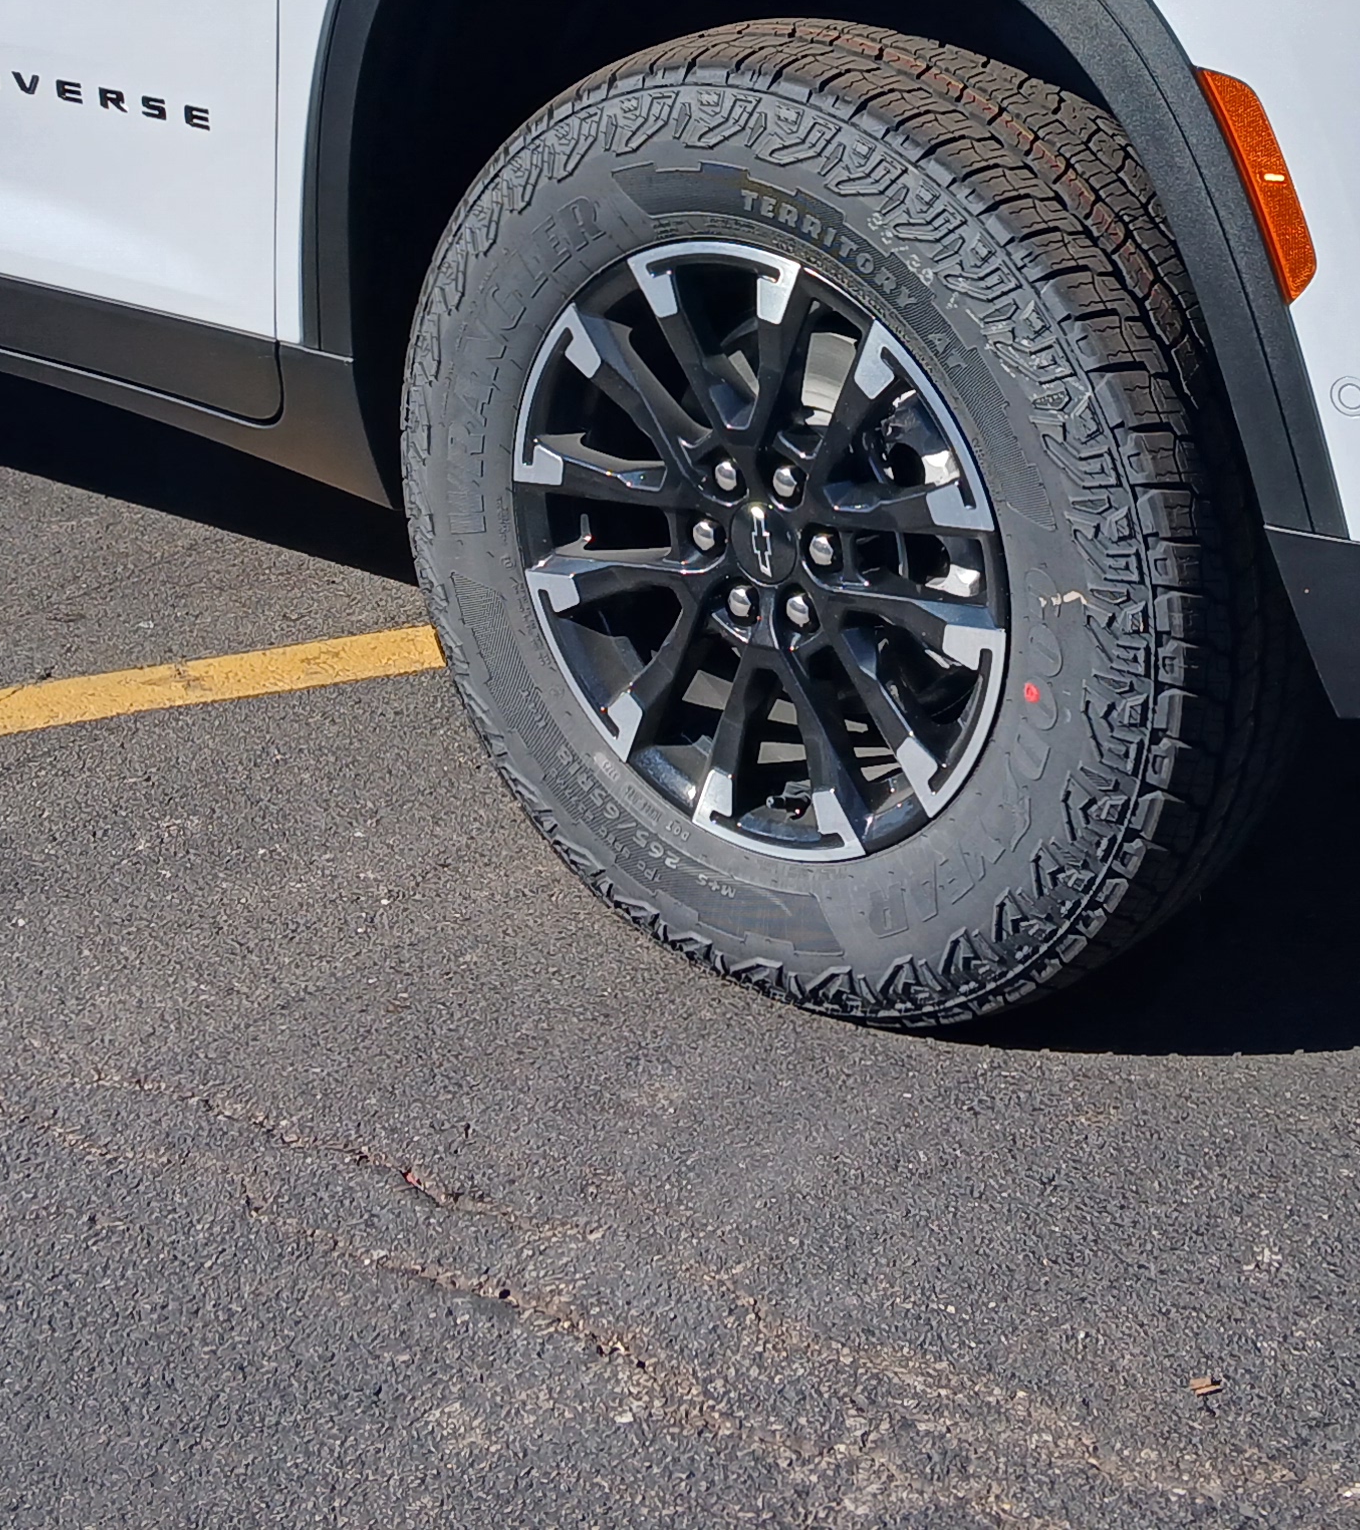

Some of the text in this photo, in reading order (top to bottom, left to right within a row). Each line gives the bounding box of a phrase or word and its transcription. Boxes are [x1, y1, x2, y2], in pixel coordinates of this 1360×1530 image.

[741, 189, 916, 308] TERRITORY
[448, 196, 606, 534] WRANGLER
[557, 746, 681, 869] 265/65R18
[665, 821, 691, 842] DOT
[696, 873, 737, 899] M+S
